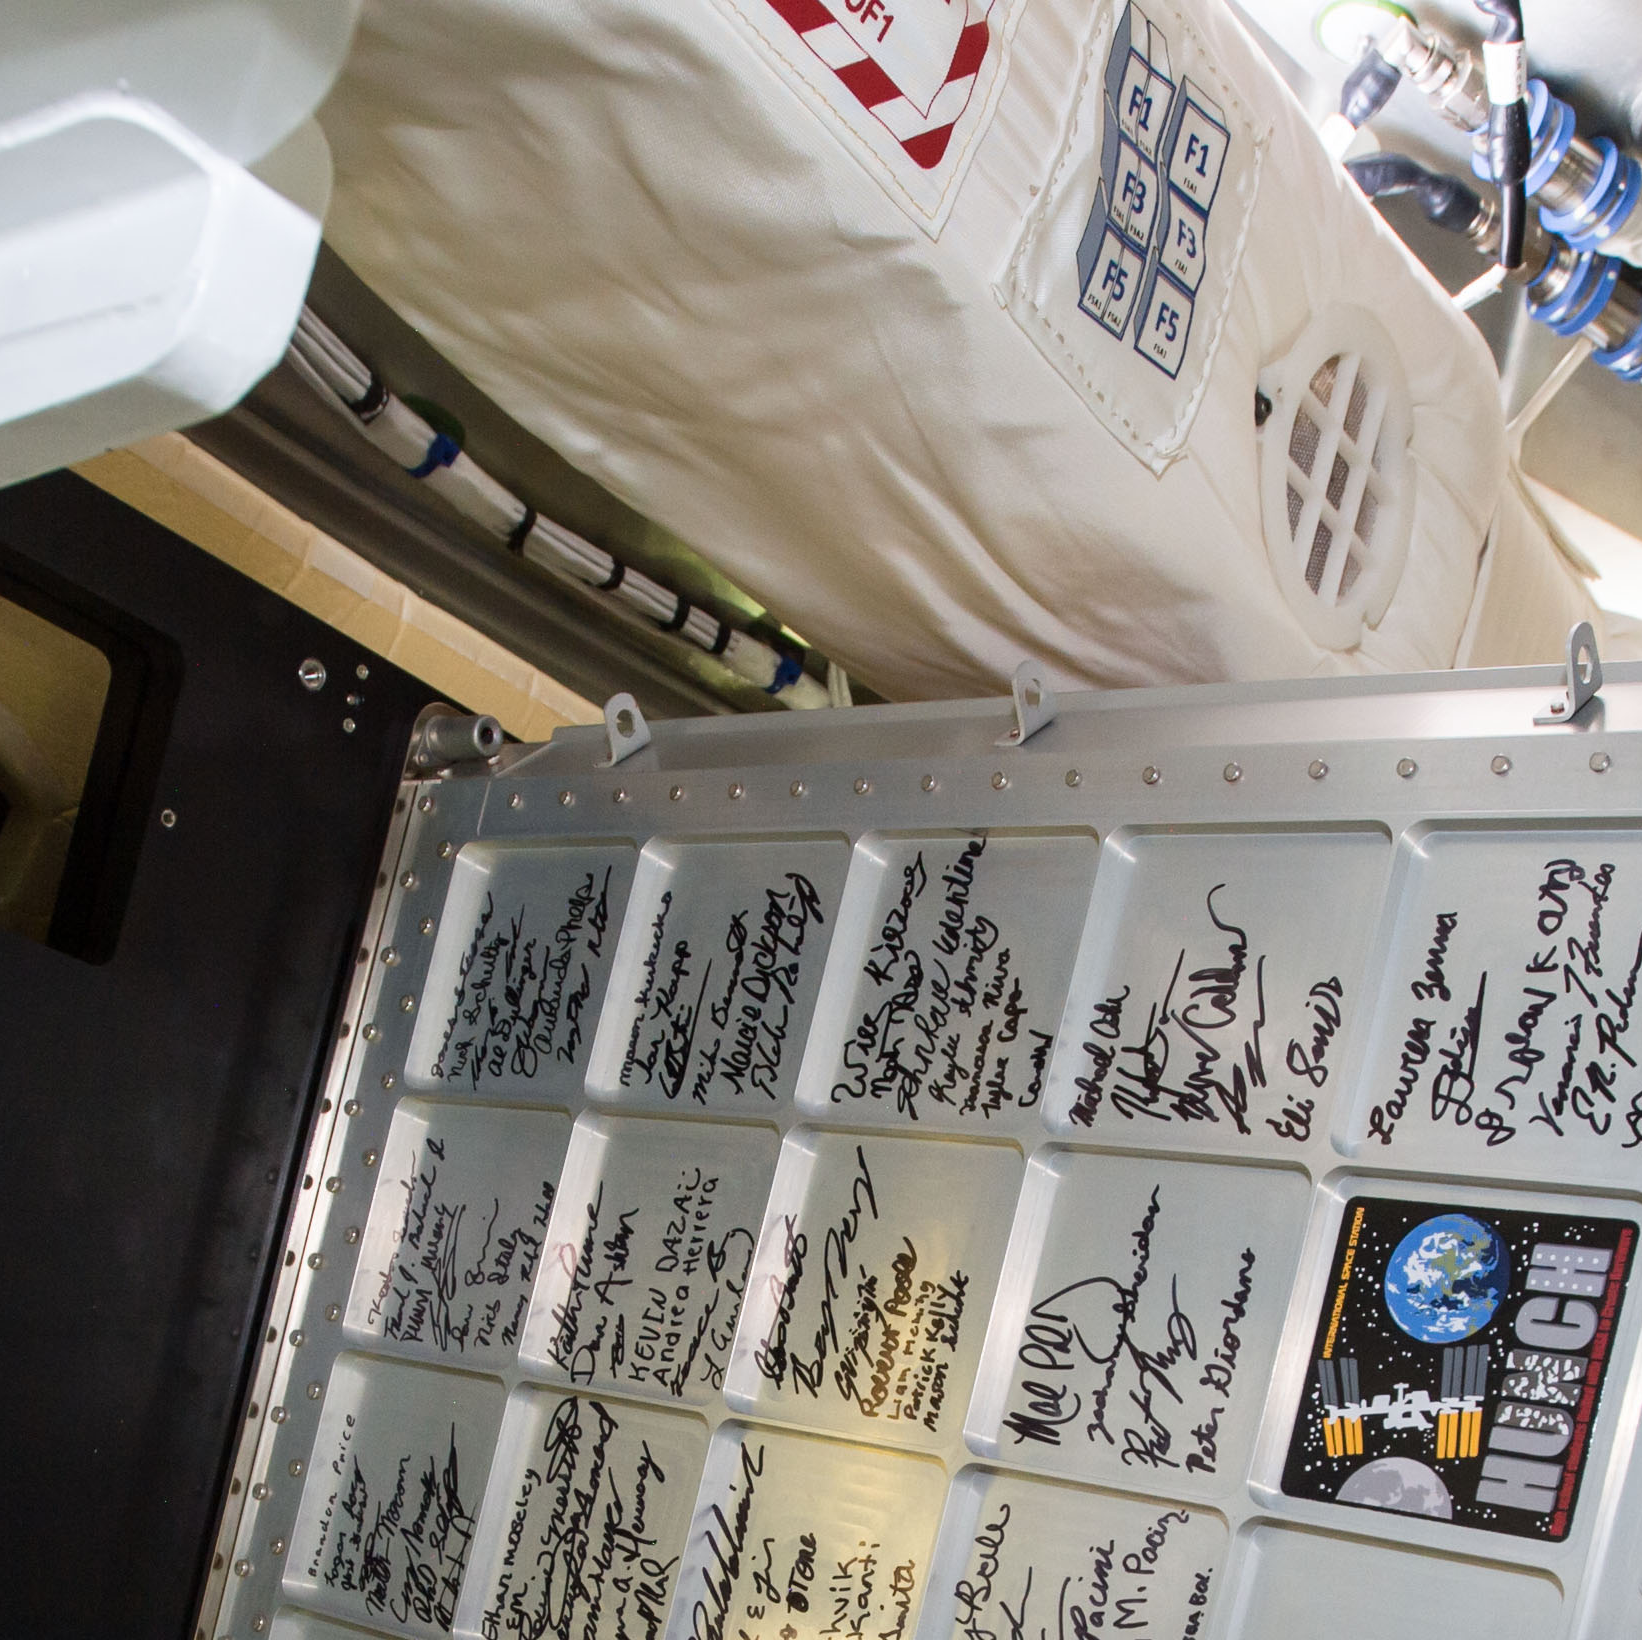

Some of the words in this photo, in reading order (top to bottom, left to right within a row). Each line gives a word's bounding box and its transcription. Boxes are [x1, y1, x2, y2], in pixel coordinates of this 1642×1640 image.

[1129, 85, 1152, 131] F1
[1184, 133, 1209, 178] F1
[1122, 170, 1146, 214] F3
[1178, 218, 1196, 258] F3
[1102, 259, 1128, 301] F5
[1156, 301, 1179, 342] F5
[652, 1285, 690, 1388] Andrea
[682, 1177, 720, 1277] Herrera
[1323, 1281, 1349, 1358] INTERNATIONAL
[1341, 1248, 1356, 1280] SPACE
[1349, 1206, 1365, 1247] STATION
[627, 1287, 668, 1383] KEVIN
[903, 1347, 937, 1421] Patrick
[924, 1283, 959, 1344] Kelly
[1475, 1242, 1614, 1514] HUNCH
[1185, 1407, 1225, 1474] Peter
[307, 1492, 338, 1578] Brandon
[332, 1414, 356, 1476] Price
[1112, 1586, 1149, 1630] M.
